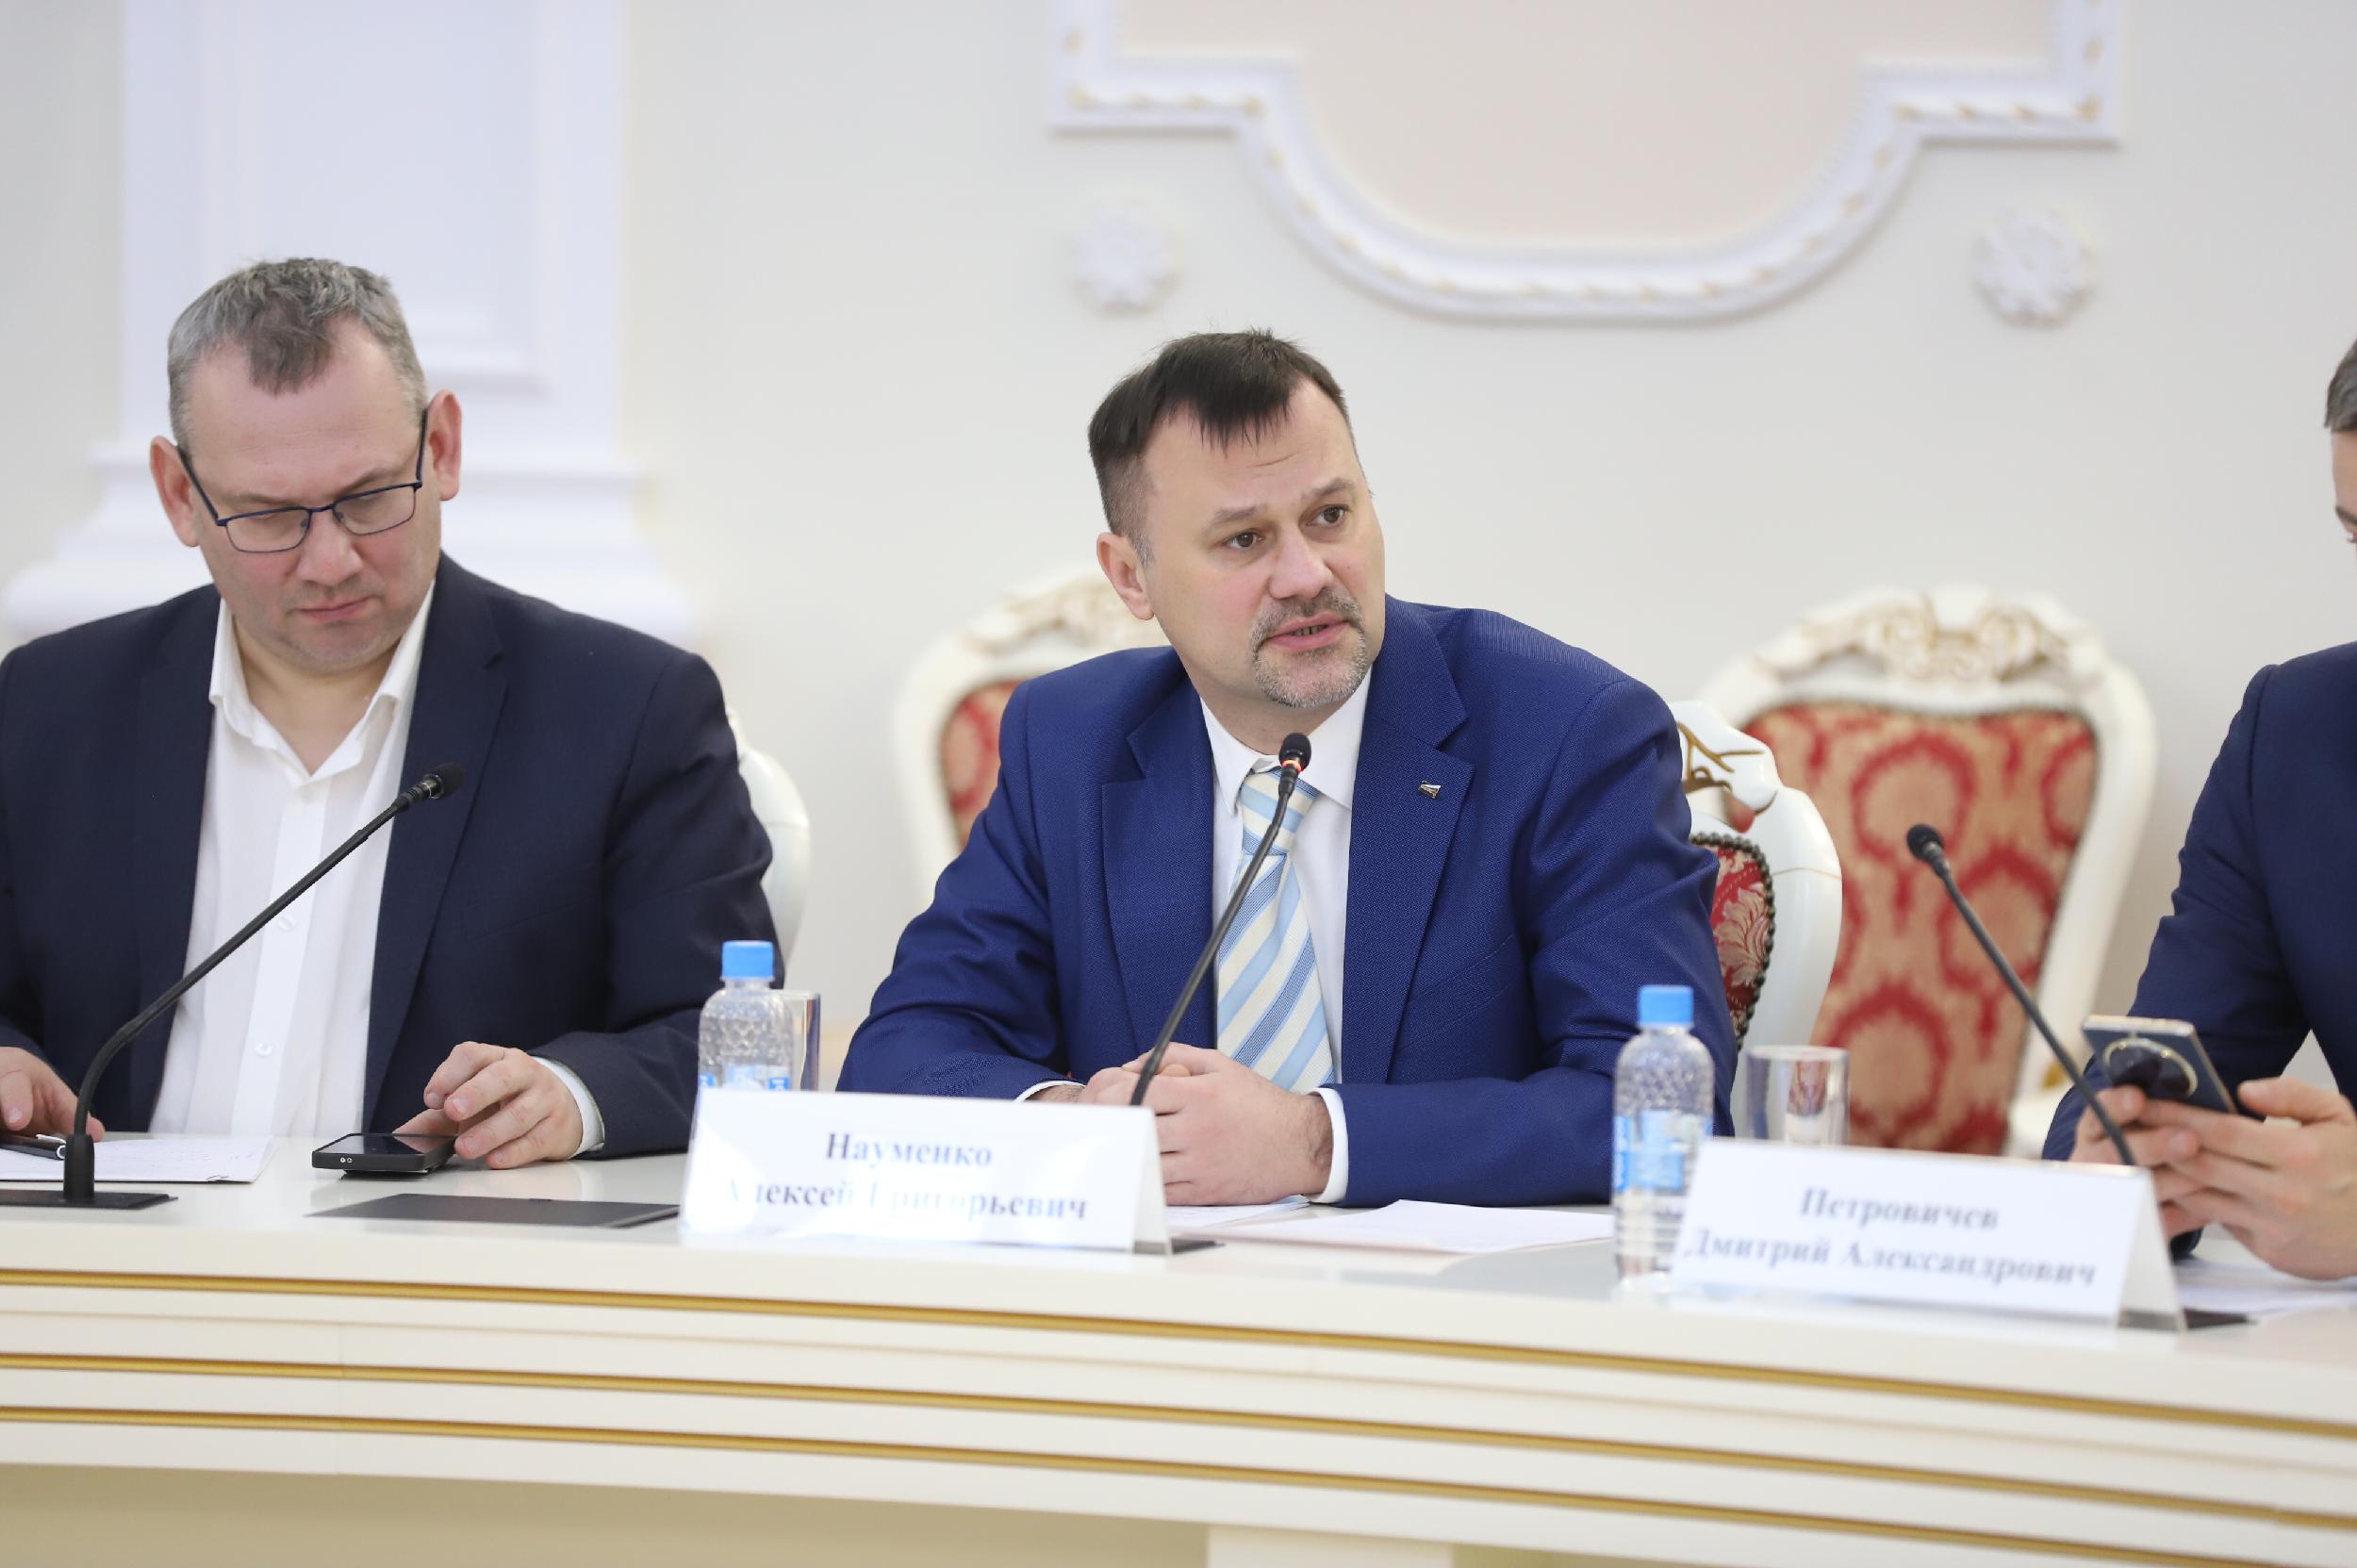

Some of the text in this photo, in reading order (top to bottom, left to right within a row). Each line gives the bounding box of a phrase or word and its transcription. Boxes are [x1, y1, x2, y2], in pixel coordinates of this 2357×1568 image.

[826, 1131, 993, 1169] Науменко
[1799, 1185, 2000, 1230] Петровичев
[1684, 1229, 1831, 1268] Дмитрий
[1840, 1240, 2097, 1288] Александрович
